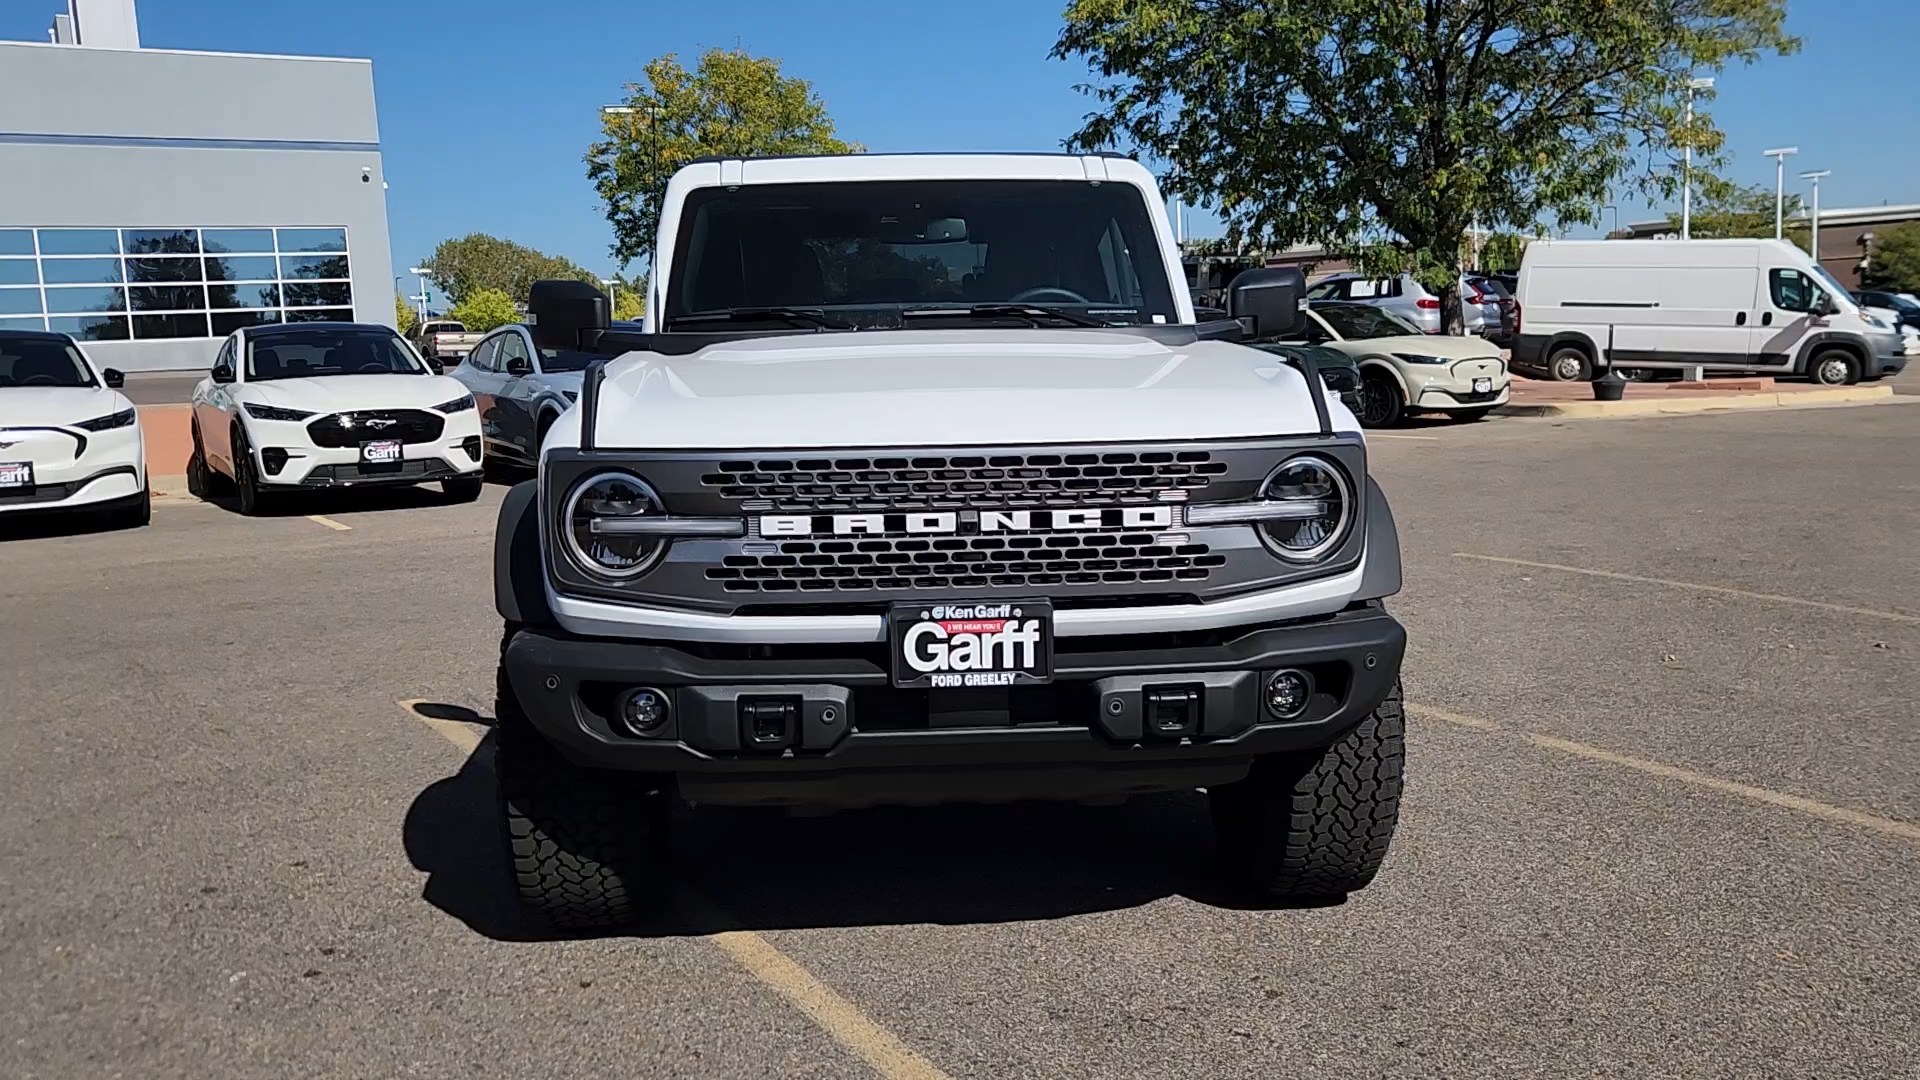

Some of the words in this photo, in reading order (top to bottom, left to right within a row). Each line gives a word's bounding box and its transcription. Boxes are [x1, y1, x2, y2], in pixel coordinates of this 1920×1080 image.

[363, 444, 400, 460] Garff
[0, 465, 30, 482] arff
[759, 505, 1174, 536] BRONCO
[974, 604, 1011, 619] Garff
[952, 623, 963, 631] WE
[963, 623, 982, 631] HEAR
[903, 619, 1040, 672] Garff
[931, 674, 962, 687] FORD
[964, 672, 1016, 686] GREELEY
